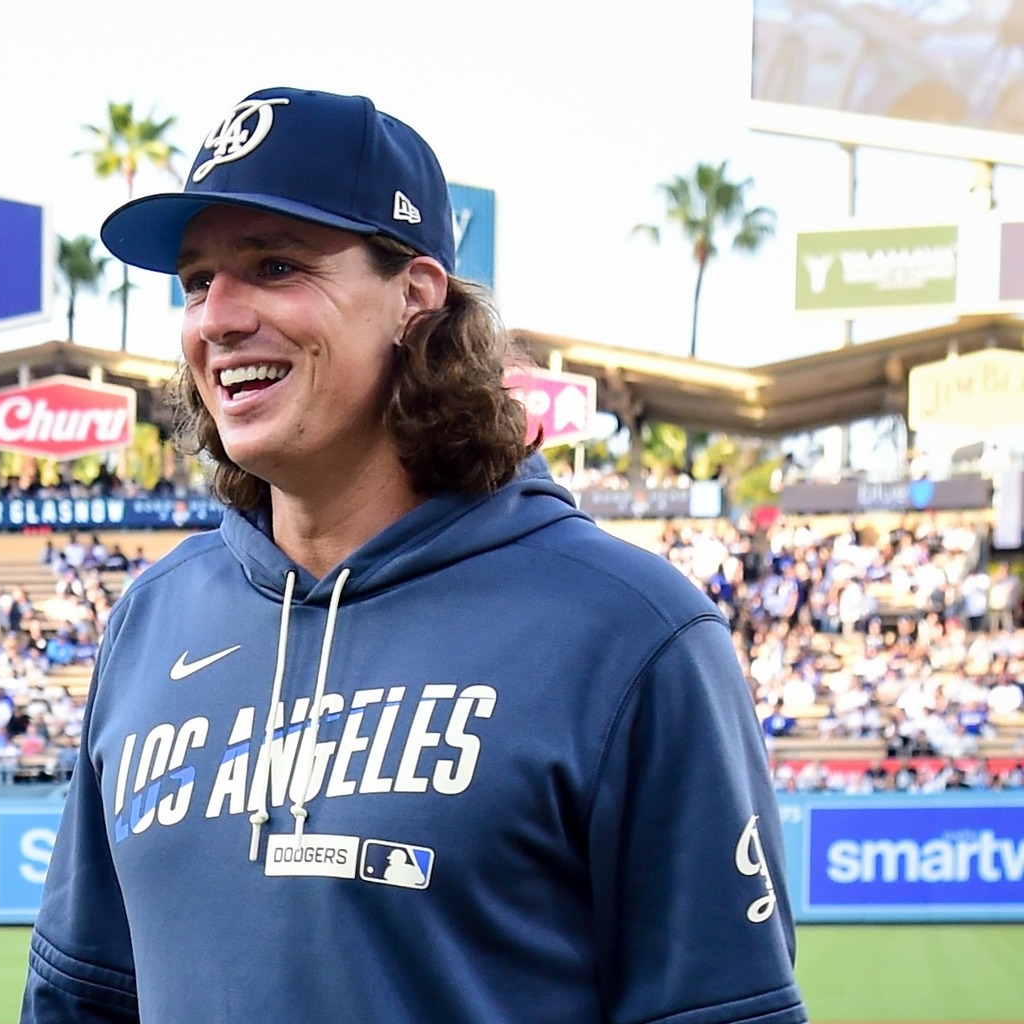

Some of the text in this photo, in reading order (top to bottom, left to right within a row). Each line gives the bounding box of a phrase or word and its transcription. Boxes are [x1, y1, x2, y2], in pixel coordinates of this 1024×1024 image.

[9, 500, 126, 526] GLASNOW
[114, 683, 498, 843] LOS ANGELES
[272, 846, 348, 866] DODGERS
